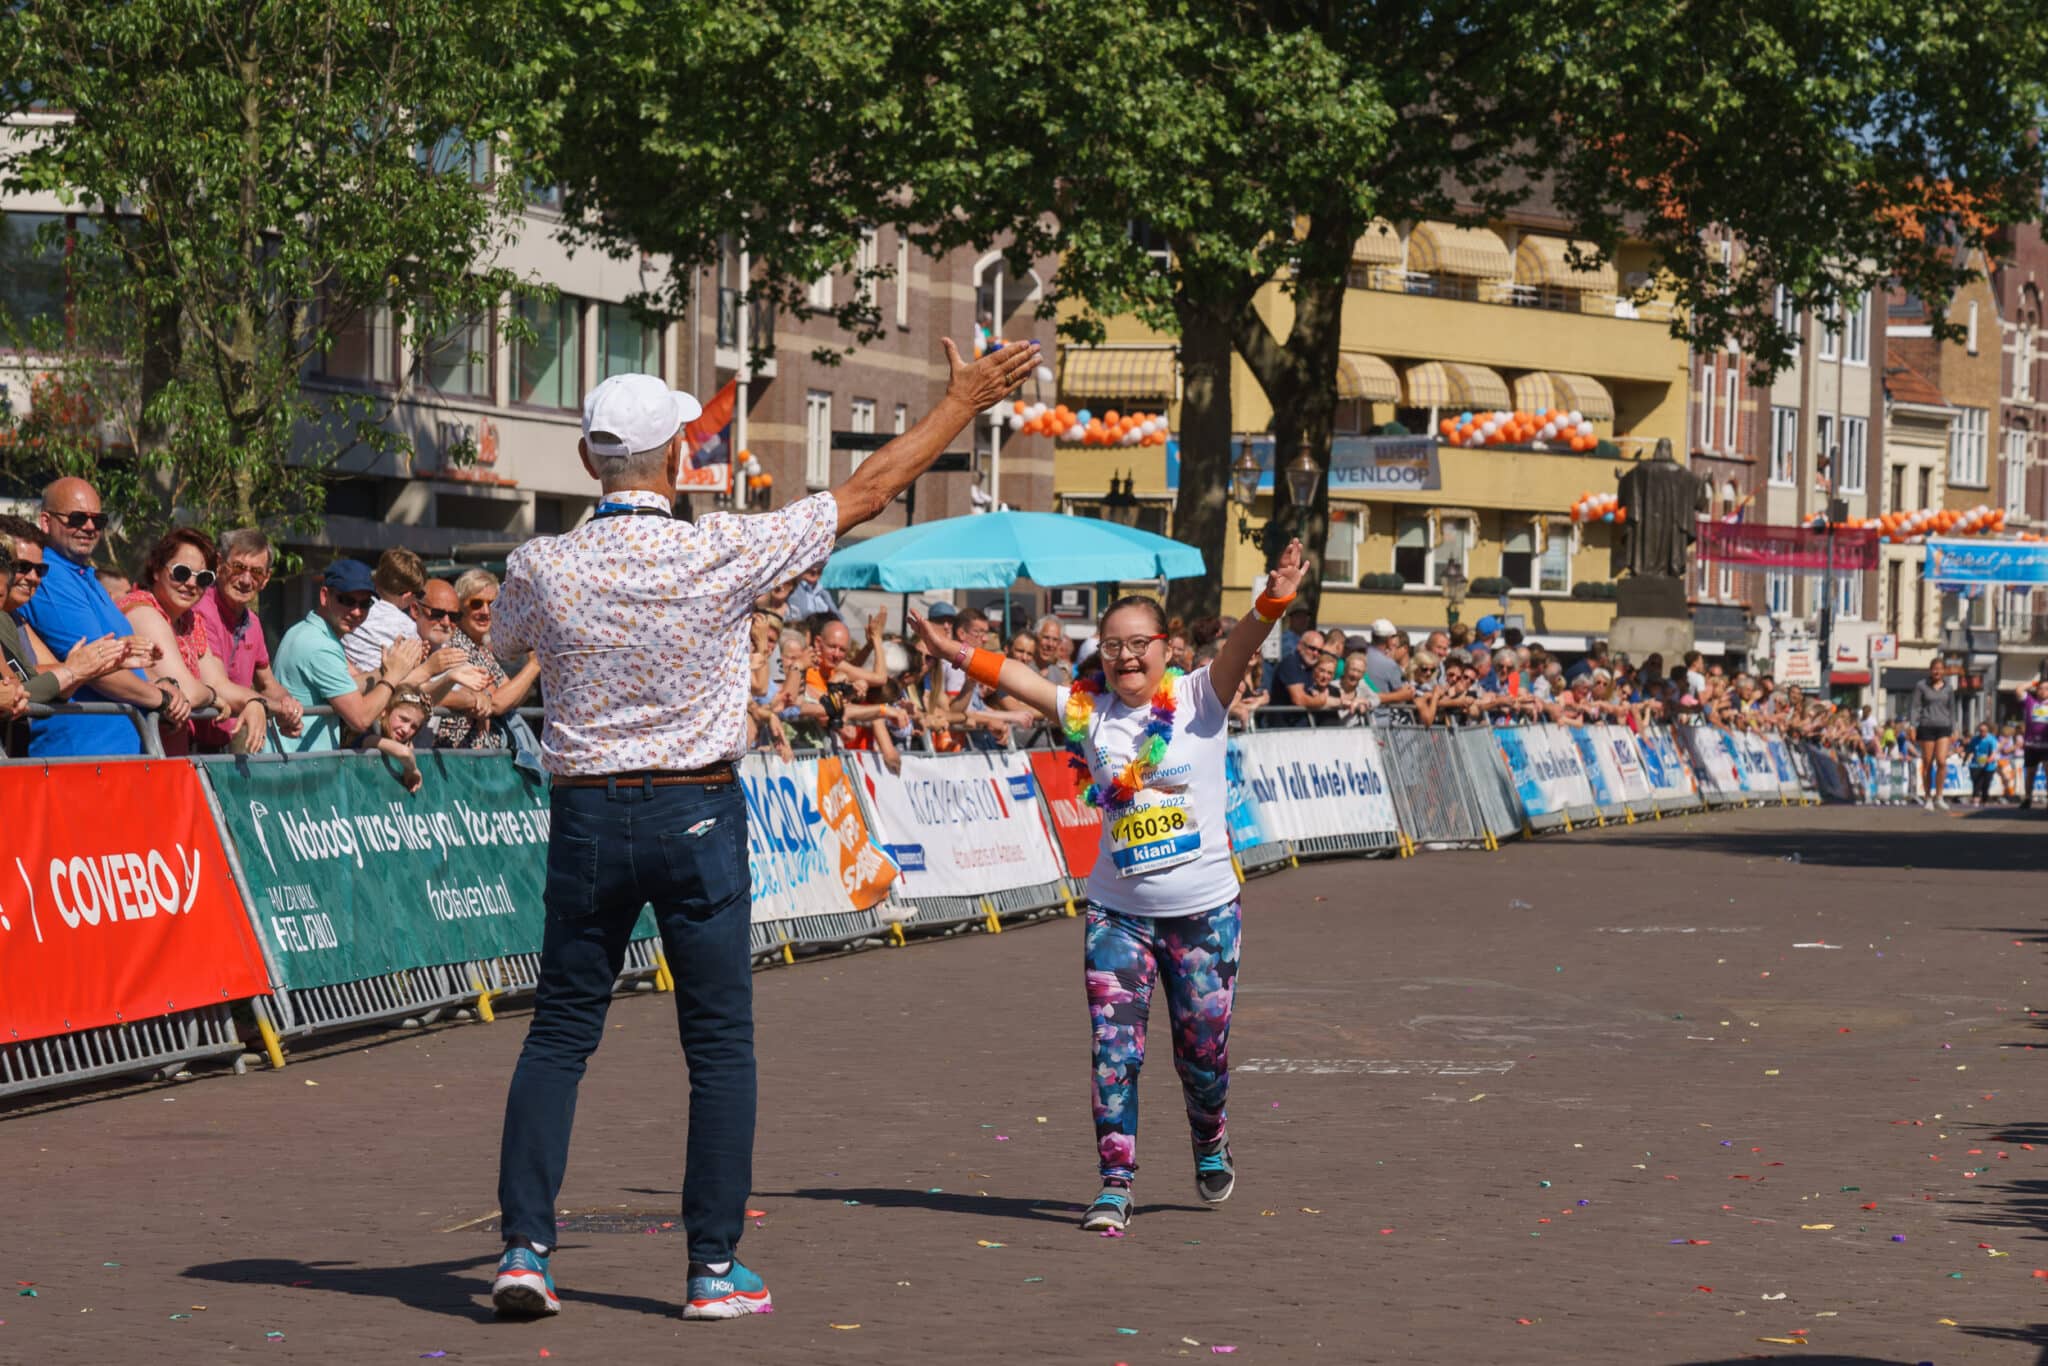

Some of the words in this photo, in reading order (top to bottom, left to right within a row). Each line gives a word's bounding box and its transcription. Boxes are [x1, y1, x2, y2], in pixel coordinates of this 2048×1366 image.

[1334, 466, 1429, 483] VENLOOP
[1160, 796, 1185, 809] 2022
[278, 805, 364, 869] Nobody
[354, 814, 401, 852] runs
[388, 801, 431, 850] like
[518, 811, 537, 844] a
[1133, 839, 1177, 862] kiani
[50, 849, 181, 929] COVEBO
